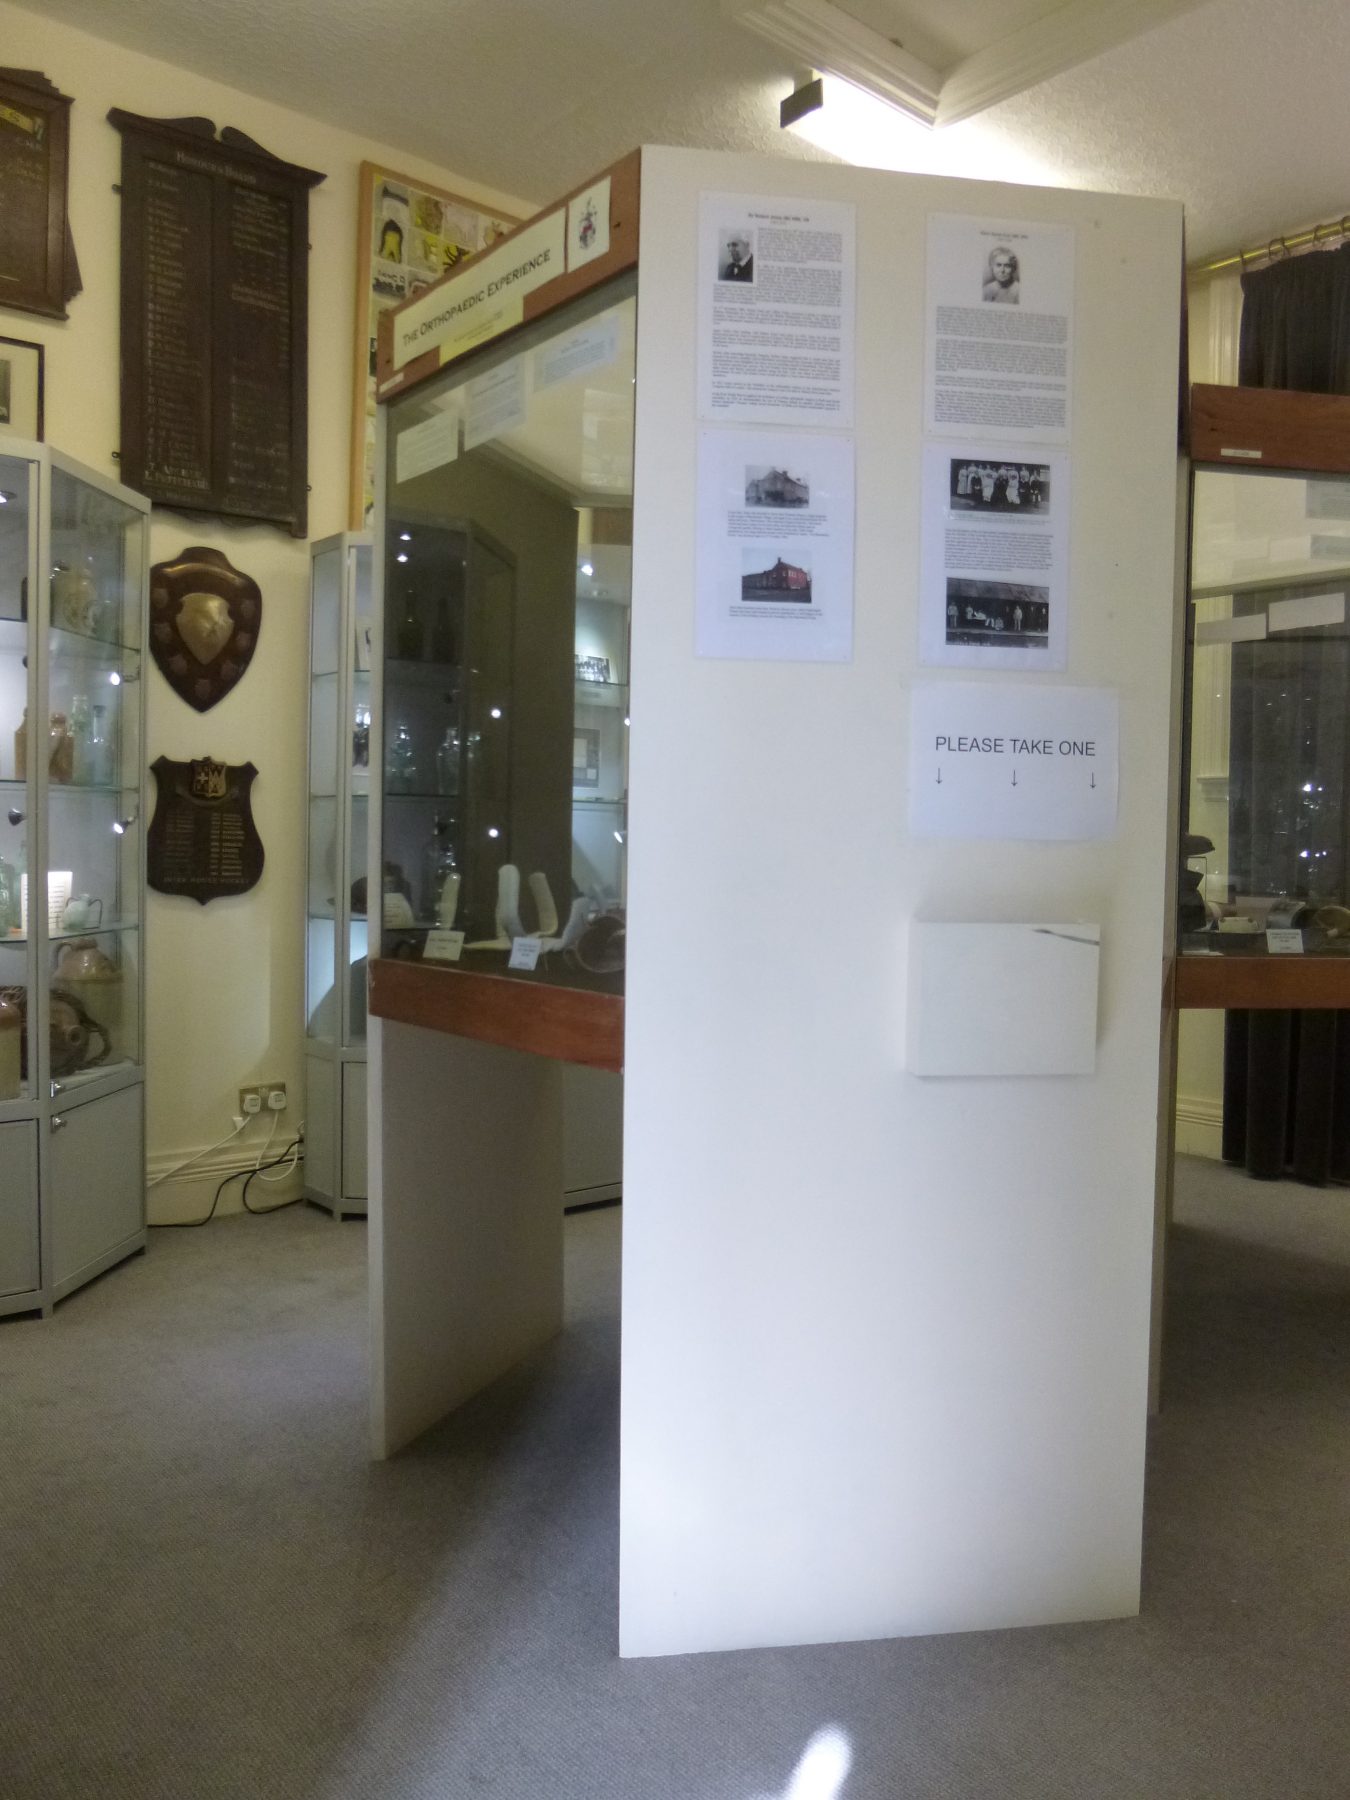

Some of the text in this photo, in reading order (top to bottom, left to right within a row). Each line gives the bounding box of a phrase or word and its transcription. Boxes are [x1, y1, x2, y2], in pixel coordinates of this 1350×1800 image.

[402, 328, 420, 347] THE
[420, 290, 485, 336] ORTHOPAEDIC
[487, 248, 552, 298] EXPERIENCE
[935, 736, 1096, 757] PLEASE TAKE ONE
